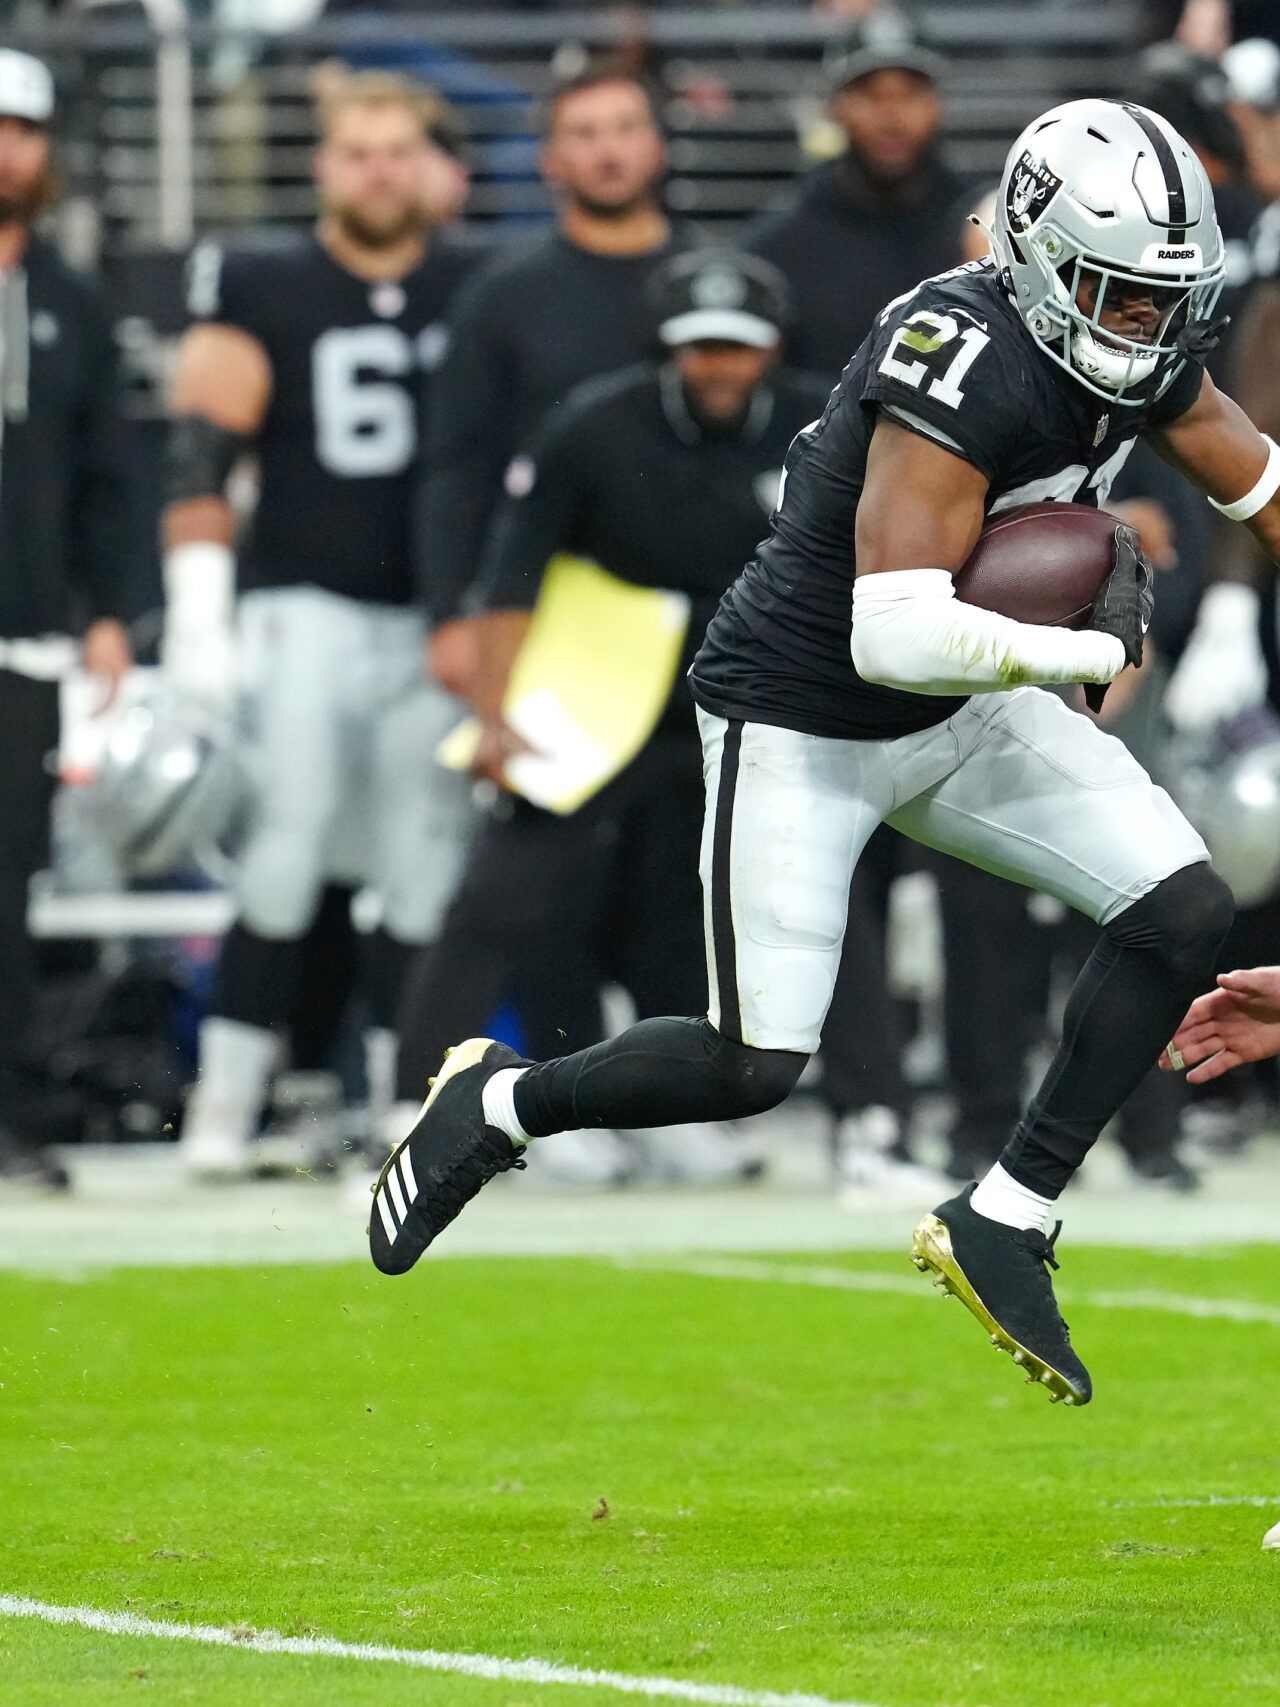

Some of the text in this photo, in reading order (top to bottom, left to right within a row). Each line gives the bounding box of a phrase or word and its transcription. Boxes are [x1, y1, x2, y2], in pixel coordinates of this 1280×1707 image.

[1157, 249, 1195, 260] RAIDERS
[312, 323, 450, 478] 6
[877, 310, 991, 410] 21
